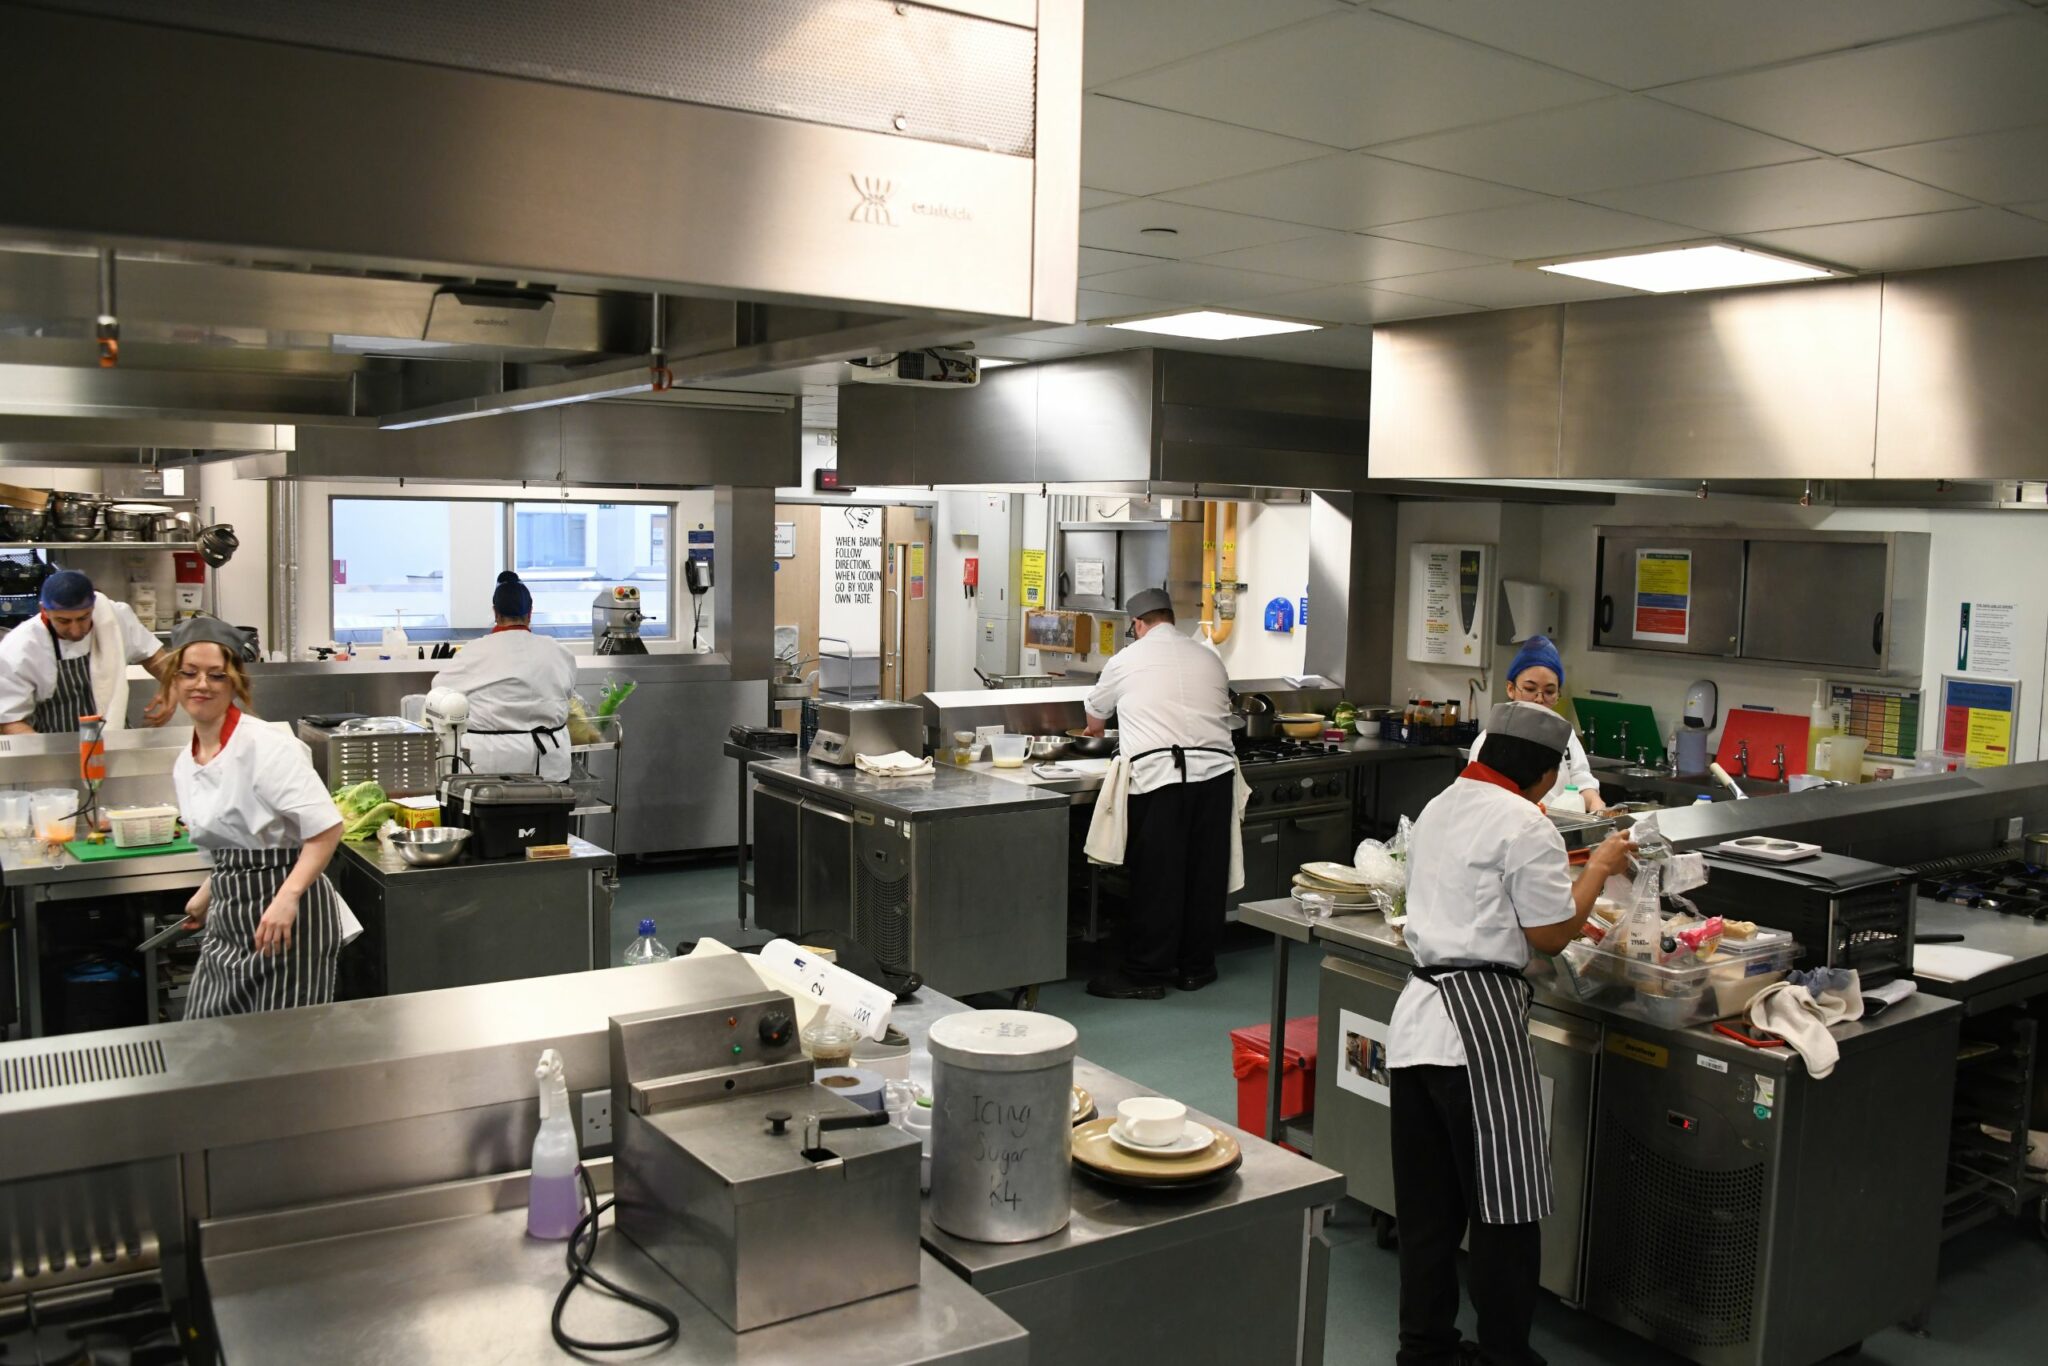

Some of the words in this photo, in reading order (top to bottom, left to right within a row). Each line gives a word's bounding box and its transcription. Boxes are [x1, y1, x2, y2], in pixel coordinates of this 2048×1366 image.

[835, 536, 856, 546] WHEN
[859, 536, 882, 547] BAKING
[835, 548, 862, 558] FOLLOW
[835, 559, 872, 570] DIRECTIONS.
[835, 571, 856, 581] WHEN
[858, 570, 882, 581] COOKIN
[835, 582, 845, 592] GO
[848, 582, 856, 592] BY
[857, 582, 874, 592] YOUR
[835, 594, 851, 604] OWN
[854, 593, 872, 604] TASTE.
[975, 1131, 1028, 1175] Sugar
